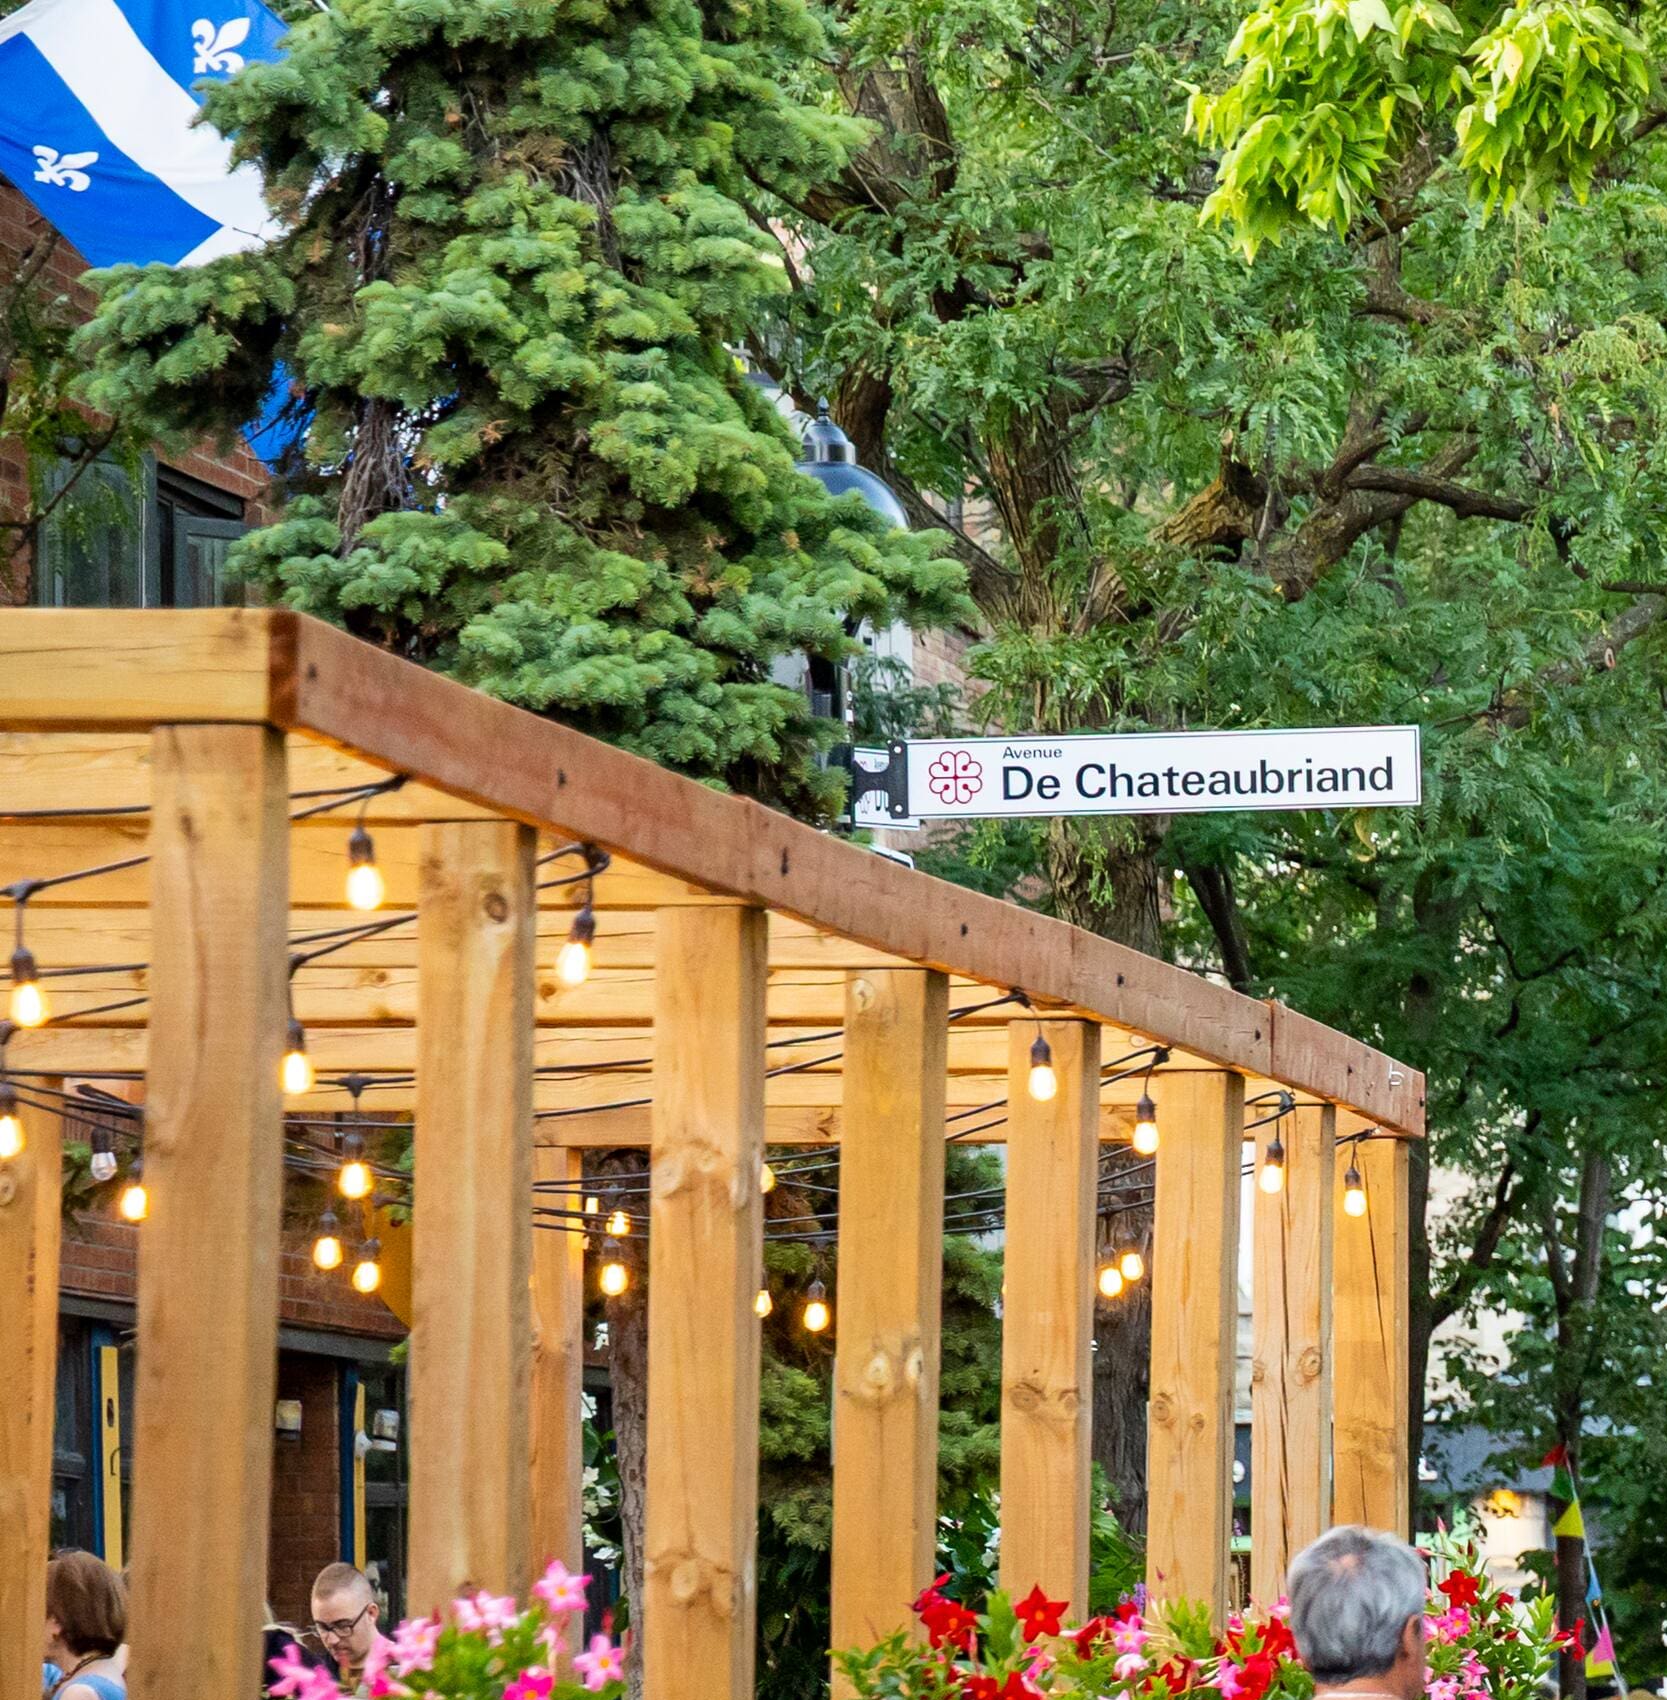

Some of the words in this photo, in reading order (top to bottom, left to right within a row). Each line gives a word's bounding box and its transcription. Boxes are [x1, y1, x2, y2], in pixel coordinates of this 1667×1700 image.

[1002, 746, 1063, 759] Avenue
[1002, 765, 1061, 800] De
[1075, 756, 1393, 798] Chateaubriand
